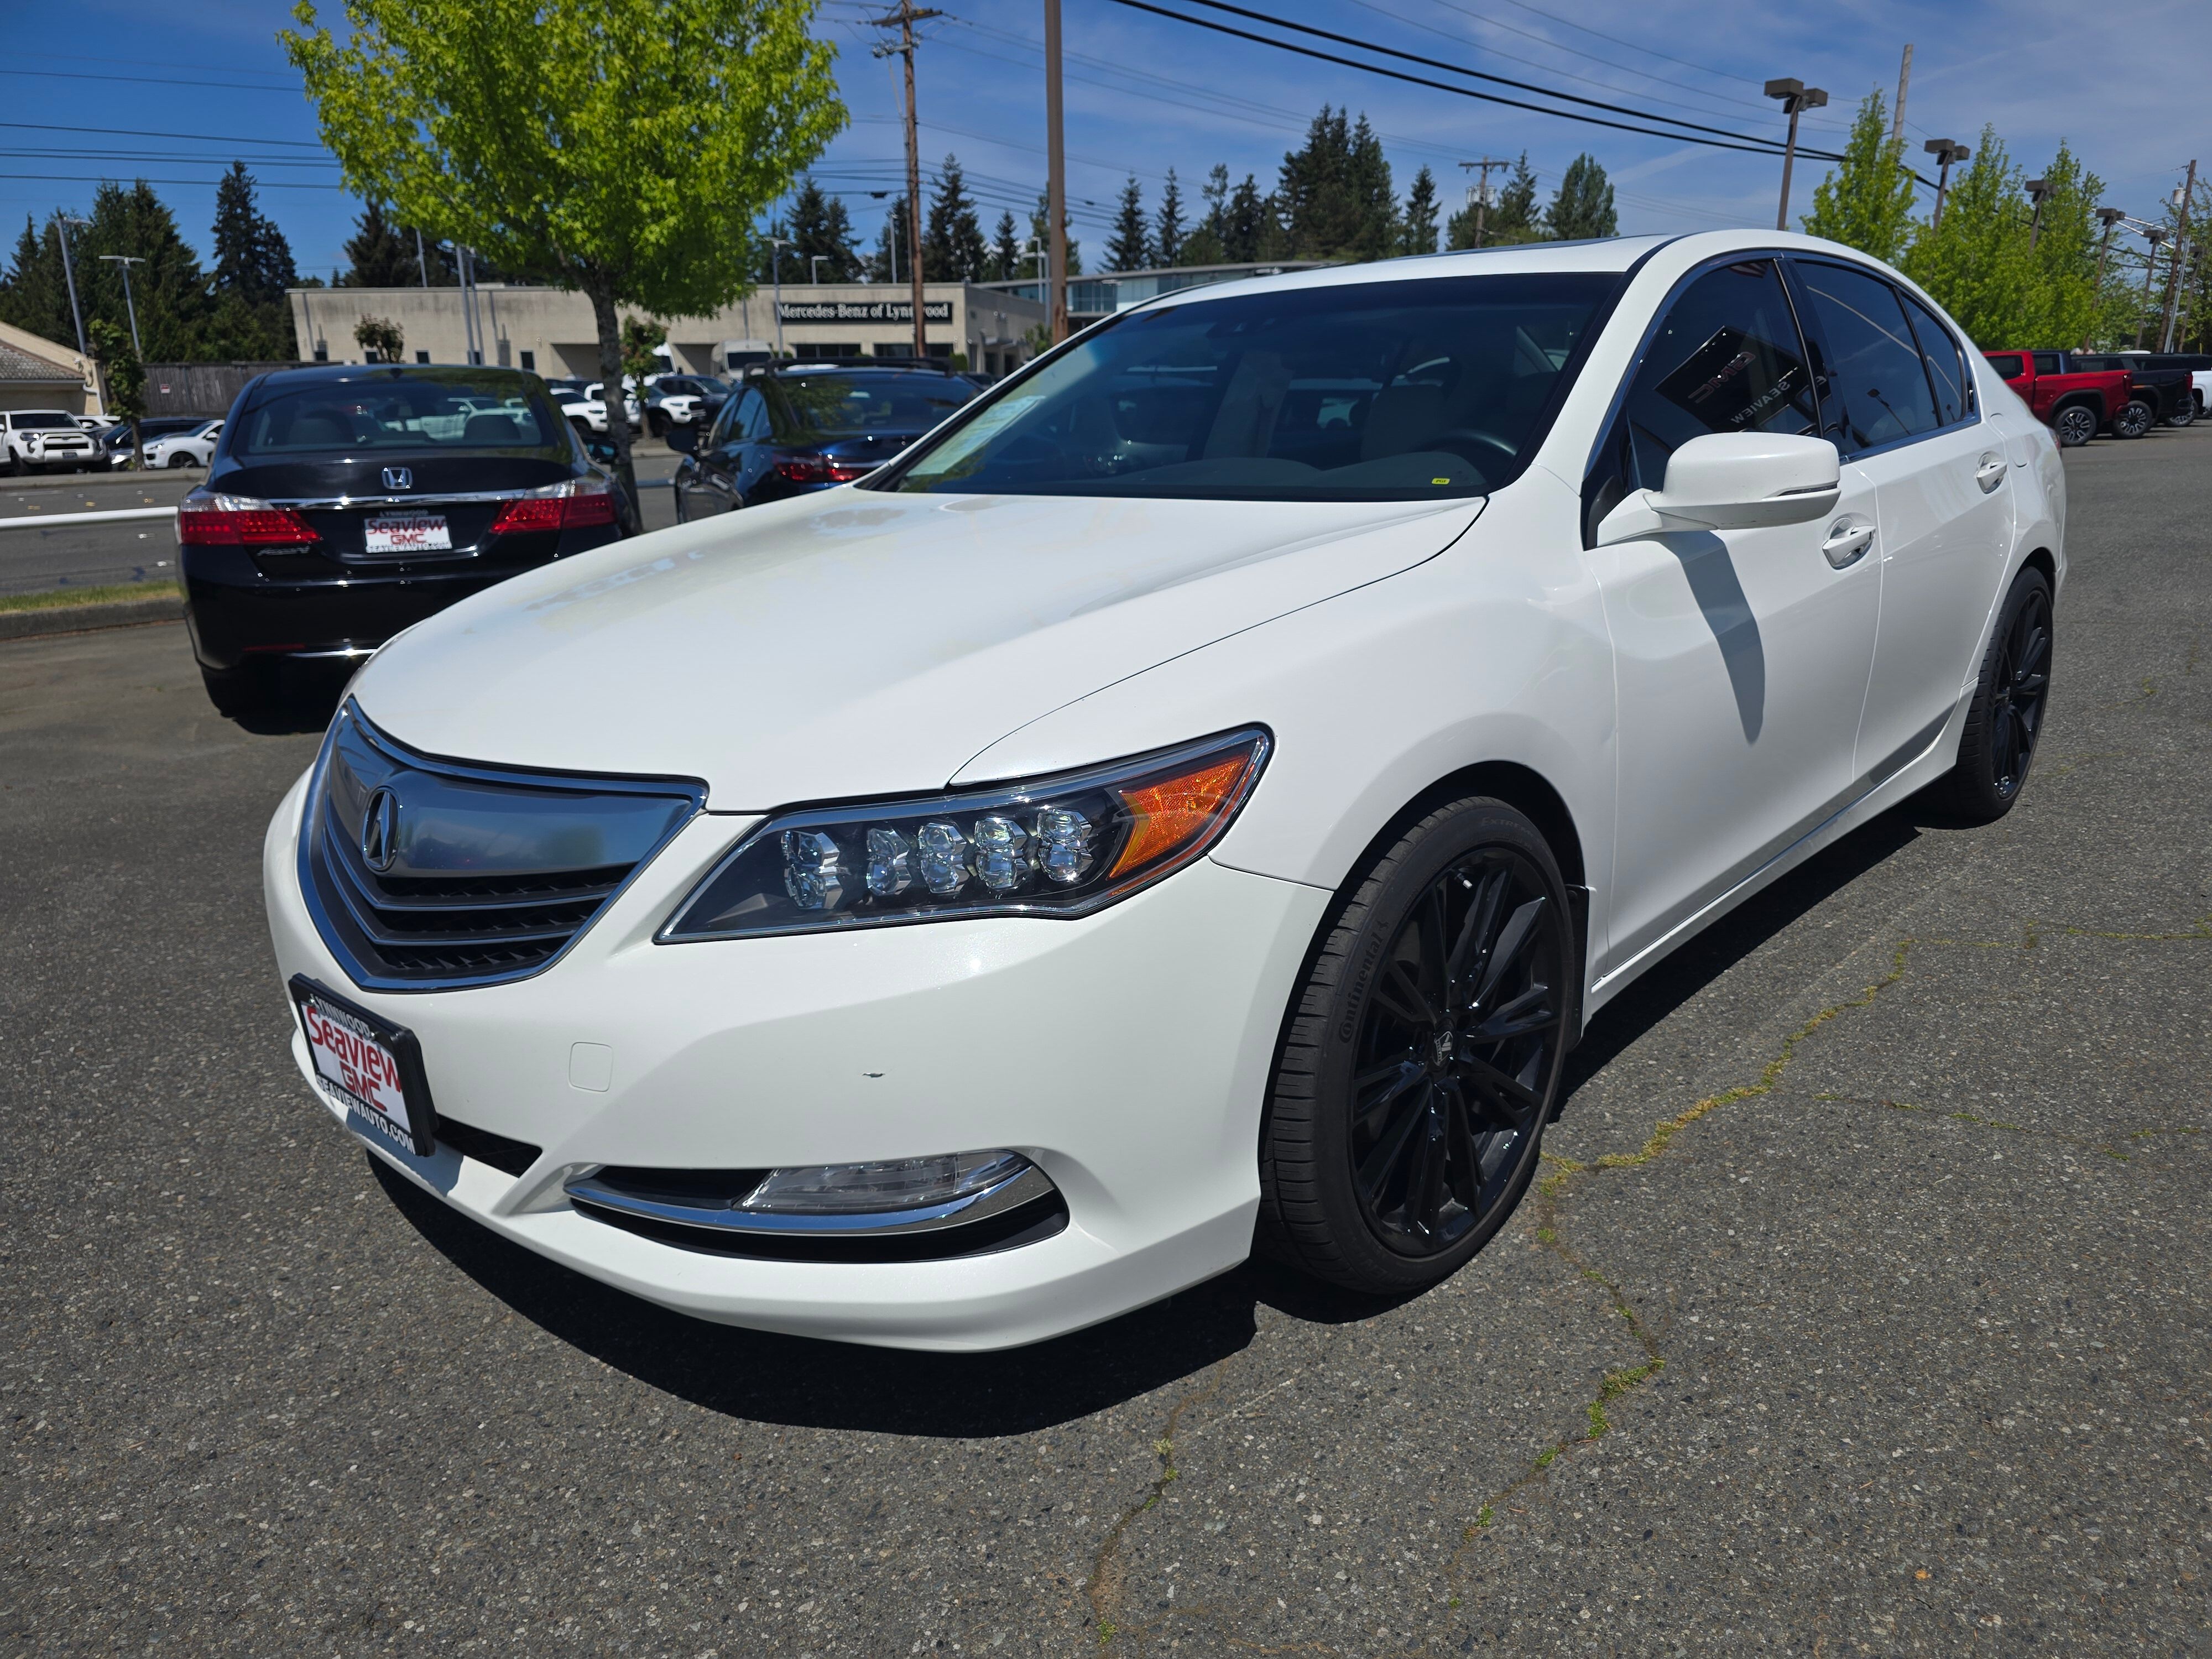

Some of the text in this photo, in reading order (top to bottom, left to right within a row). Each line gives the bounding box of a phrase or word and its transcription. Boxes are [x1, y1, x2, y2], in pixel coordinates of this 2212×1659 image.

[870, 304, 883, 317] of
[886, 303, 948, 321] Lynood
[367, 516, 447, 535] Seaview
[390, 534, 427, 544] GMC
[1338, 931, 1383, 1044] Continental
[306, 1006, 403, 1093] Seaview
[339, 1060, 388, 1112] GMC
[316, 1074, 416, 1155] SEAVIEWAUTO.COM
